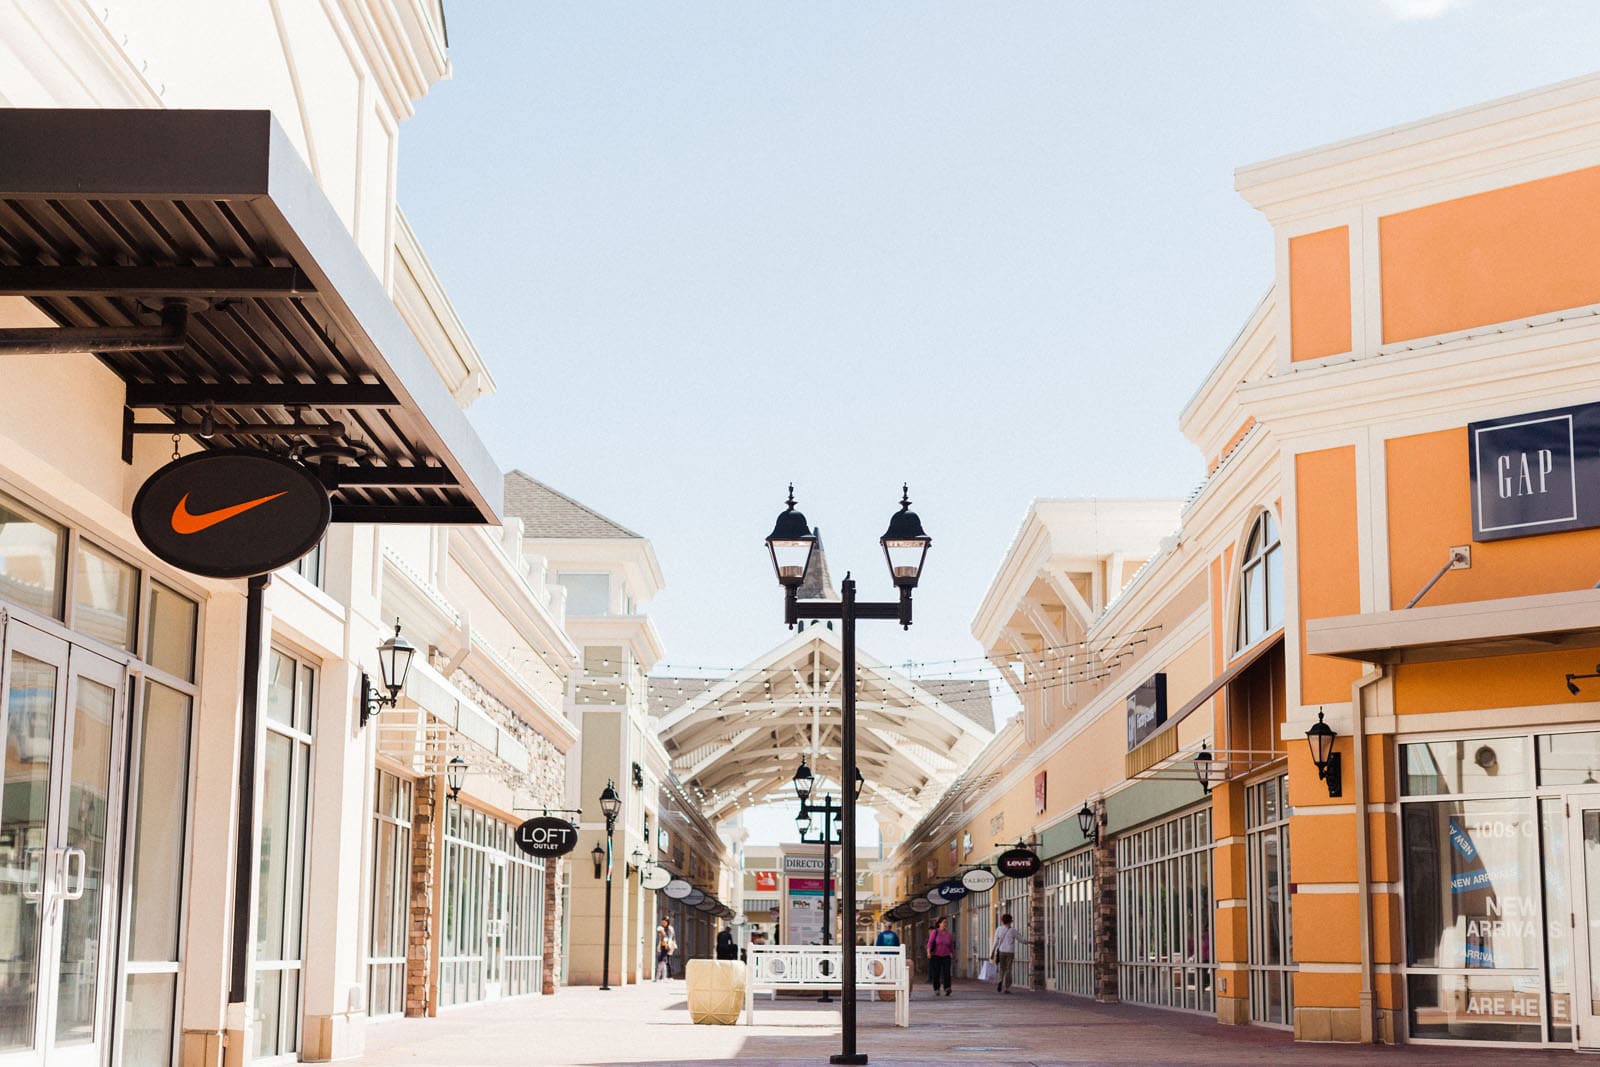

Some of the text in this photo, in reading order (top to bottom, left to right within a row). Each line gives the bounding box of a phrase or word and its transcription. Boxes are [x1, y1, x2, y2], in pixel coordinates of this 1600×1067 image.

[1497, 449, 1552, 499] GAP
[522, 827, 571, 844] LOFT
[1454, 835, 1474, 855] NEW
[786, 858, 834, 869] DIRECTOY
[1451, 876, 1471, 889] NEW
[1485, 896, 1536, 917] NEW
[1466, 920, 1562, 938] ARRIVAS
[1466, 997, 1568, 1018] ARE HEE
